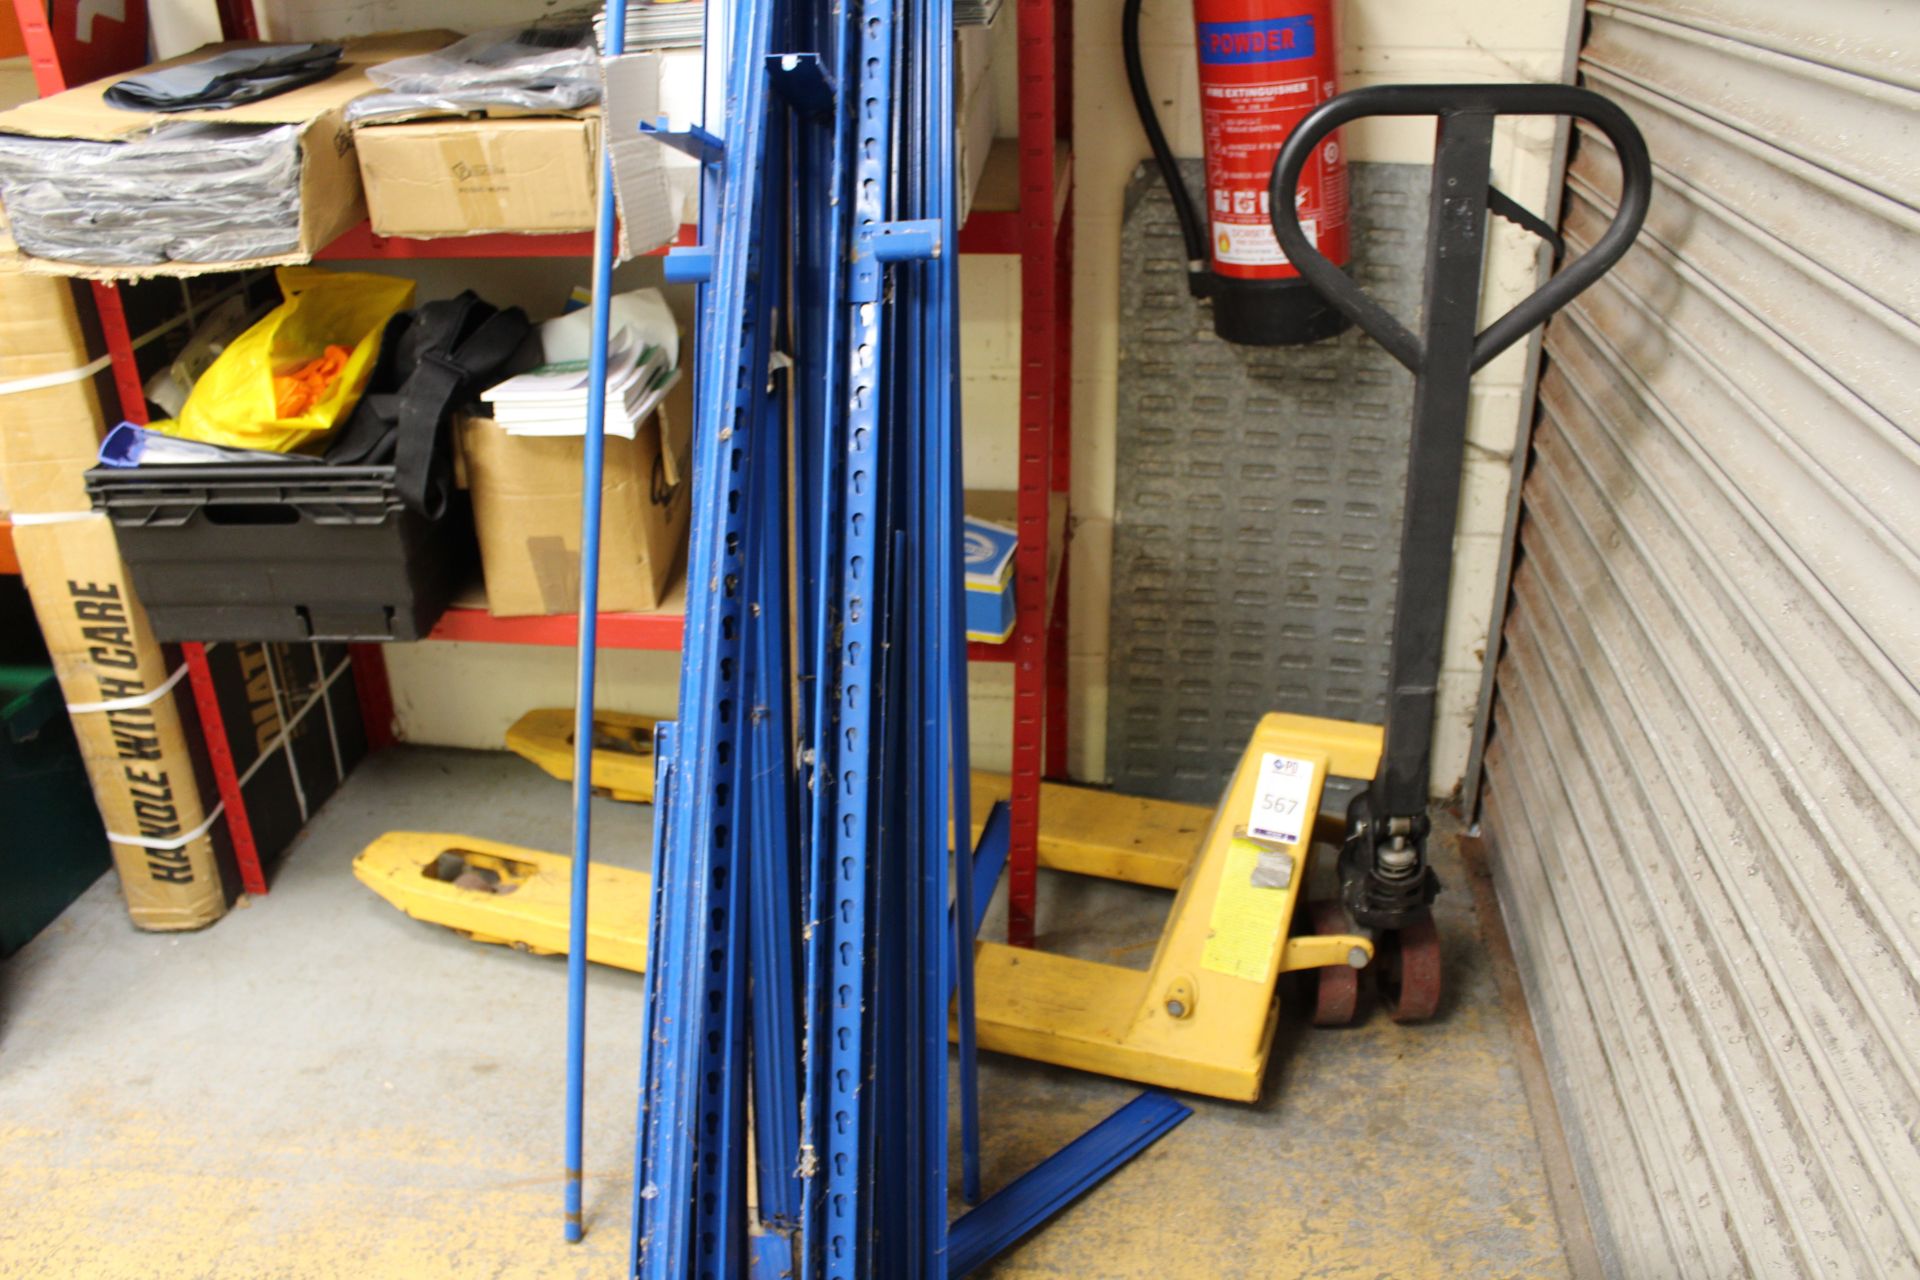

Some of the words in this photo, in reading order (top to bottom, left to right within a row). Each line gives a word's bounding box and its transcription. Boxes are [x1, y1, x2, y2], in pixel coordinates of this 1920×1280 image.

[1210, 28, 1296, 55] POWDER
[1225, 82, 1308, 98] EXTINGUISHER
[67, 579, 138, 672] CARE
[98, 675, 163, 761] WITH
[124, 765, 194, 885] HANDLE
[1262, 793, 1298, 815] 567
